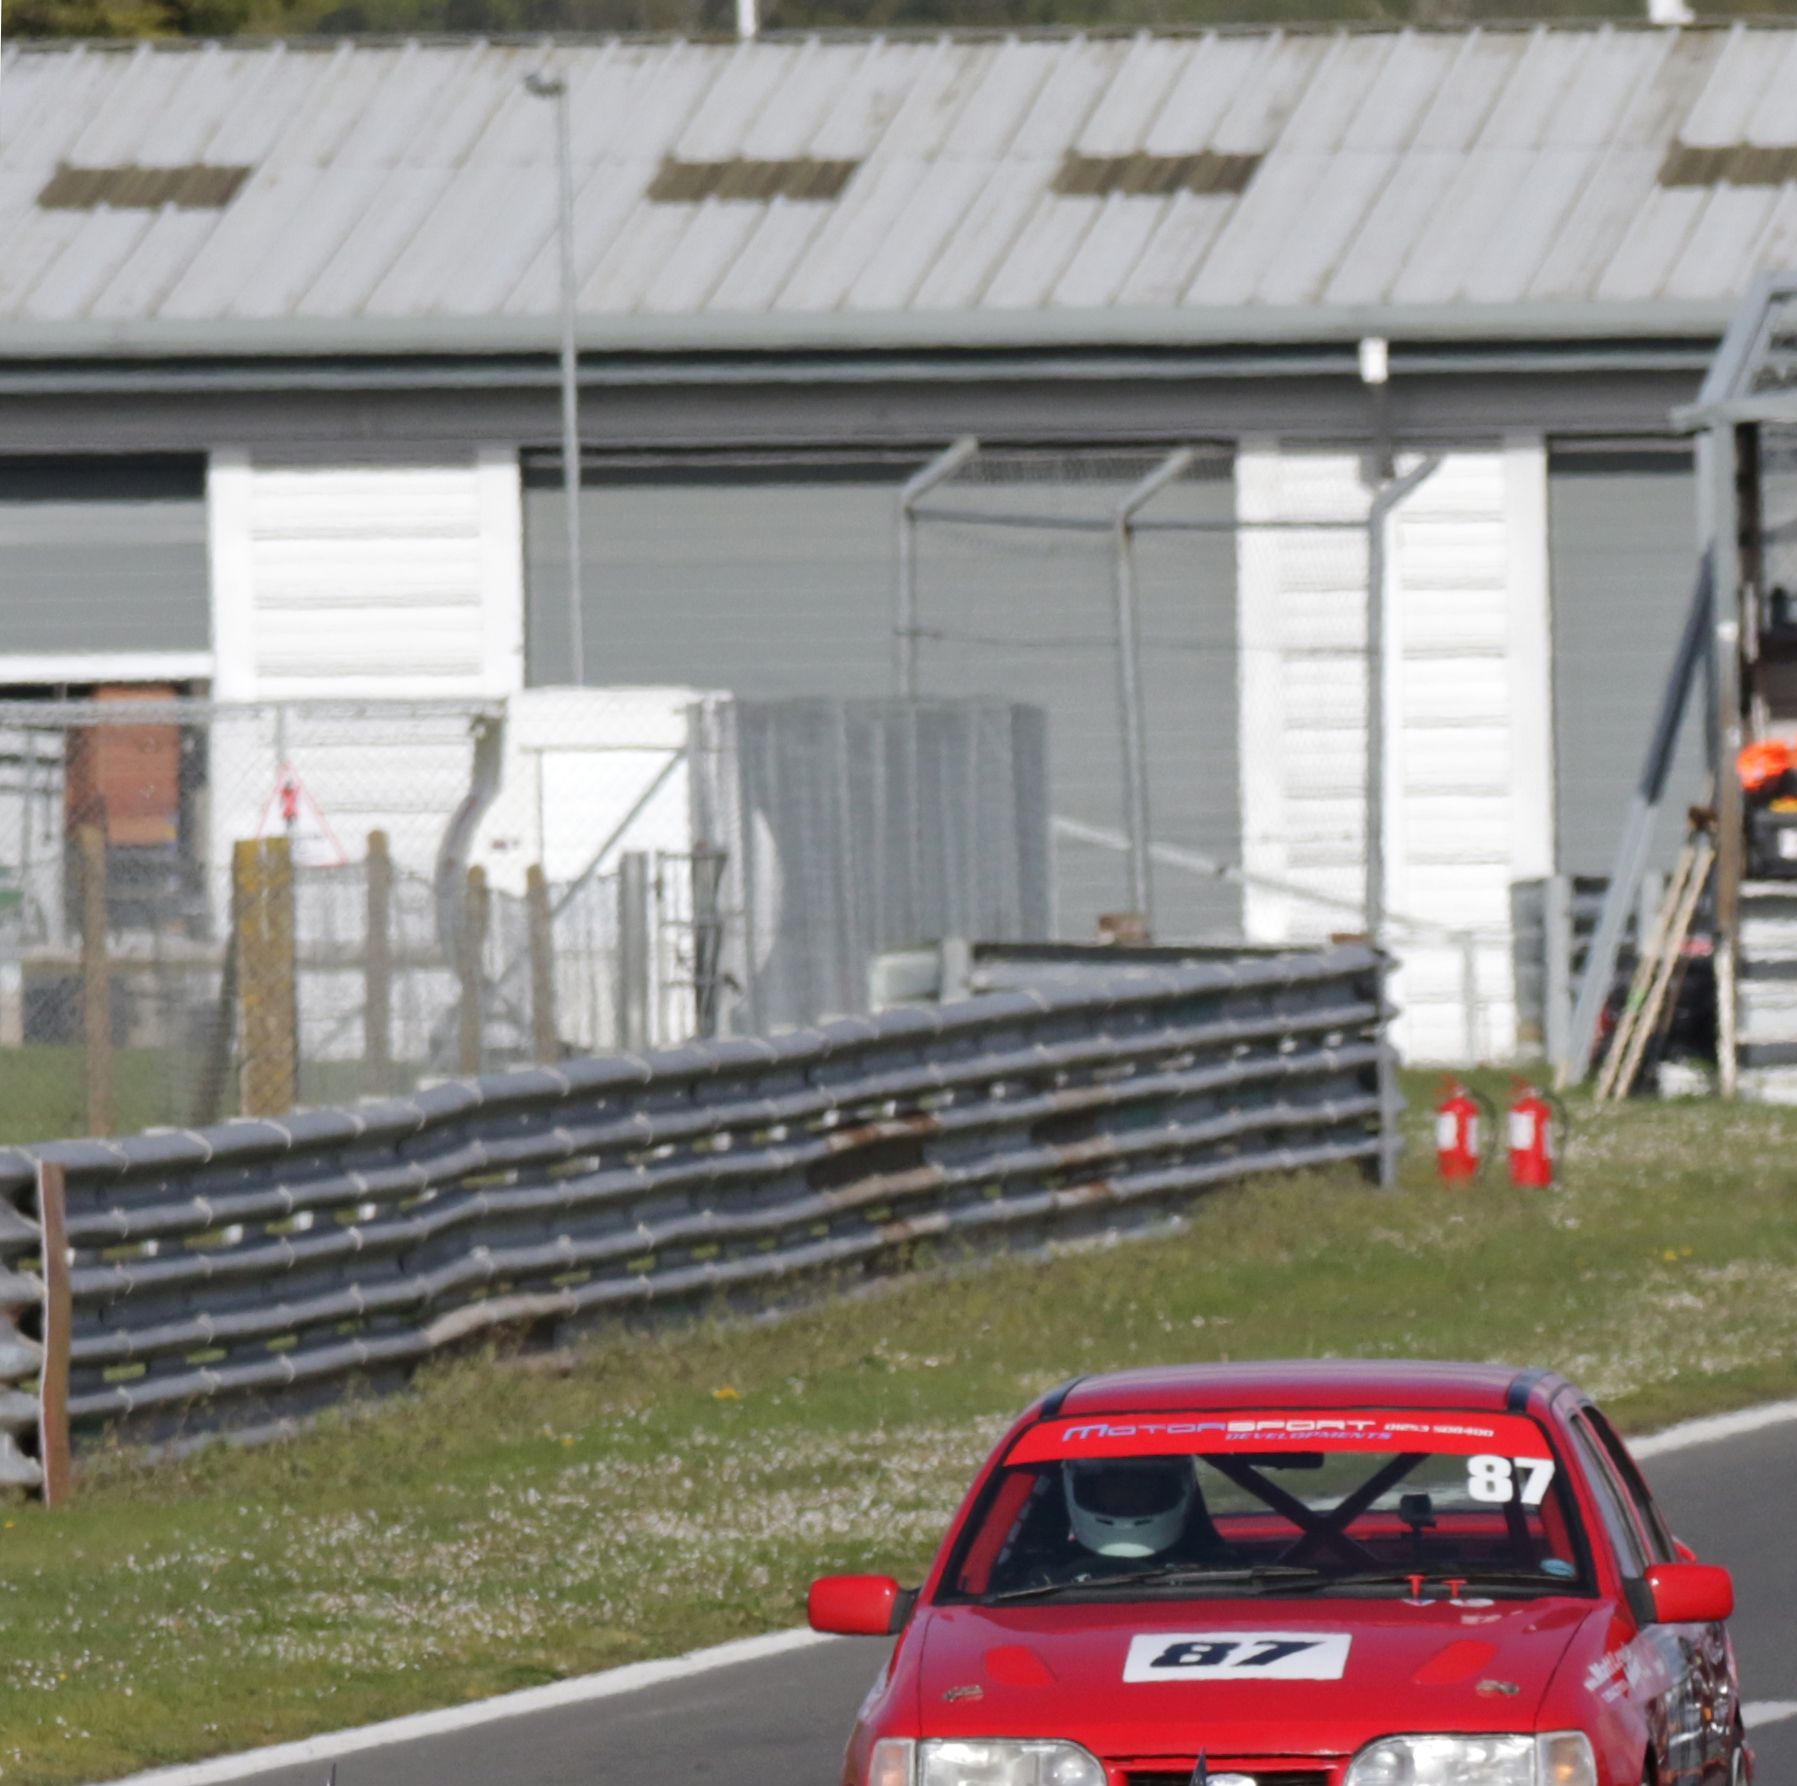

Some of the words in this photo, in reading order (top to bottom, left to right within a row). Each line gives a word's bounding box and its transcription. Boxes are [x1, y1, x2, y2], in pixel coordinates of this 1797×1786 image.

[1225, 1431, 1394, 1442] DEVELOPMENTS
[1467, 1454, 1555, 1506] 87
[1150, 1640, 1327, 1668] 87
